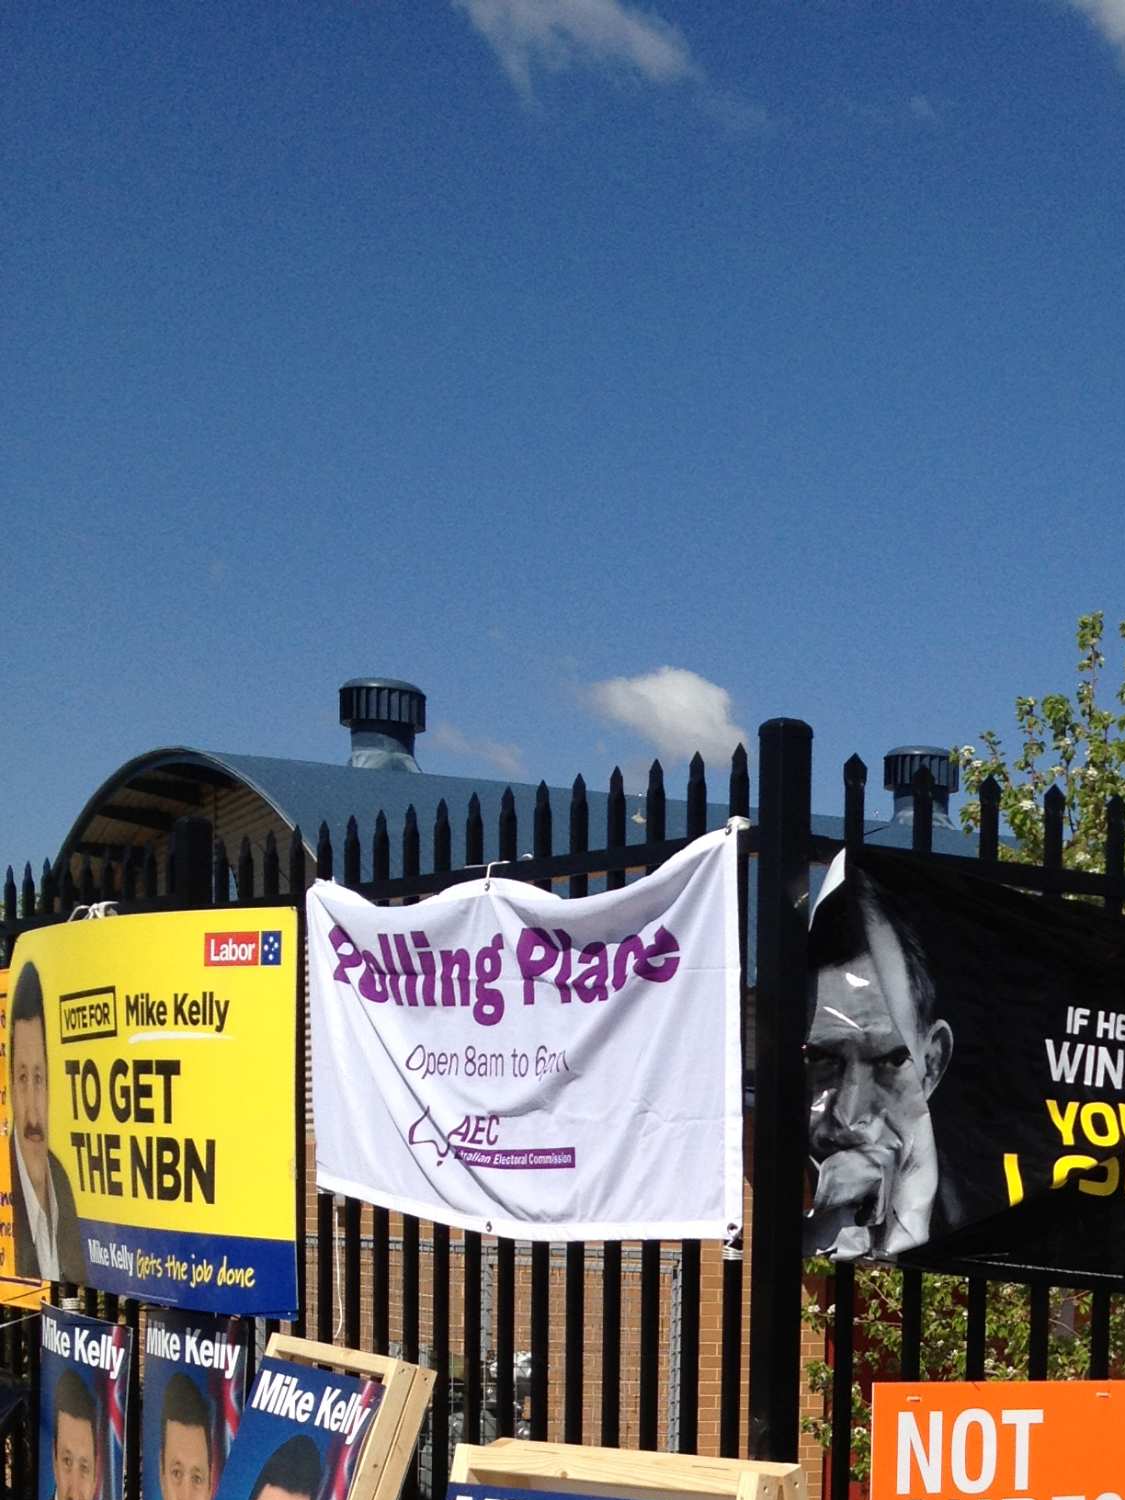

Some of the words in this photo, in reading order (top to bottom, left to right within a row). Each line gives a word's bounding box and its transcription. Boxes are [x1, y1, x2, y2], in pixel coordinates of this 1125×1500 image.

[209, 938, 256, 963] Labor
[328, 925, 505, 1027] Polling
[516, 925, 680, 1006] Place
[64, 1005, 88, 1032] VOTE
[88, 1002, 111, 1029] FOR
[125, 994, 167, 1028] Mike
[173, 991, 230, 1034] Kelly
[1067, 1005, 1089, 1036] IF
[405, 1044, 459, 1080] Open
[464, 1045, 504, 1078] 8am
[511, 1048, 529, 1078] to
[65, 1059, 101, 1122] TO
[110, 1059, 181, 1124] GET
[452, 1114, 500, 1146] AEC
[70, 1132, 123, 1197] THE
[131, 1137, 216, 1204] NBN
[493, 1154, 527, 1165] Electoral
[529, 1153, 572, 1165] Commission
[88, 1238, 109, 1266] Mike
[109, 1242, 134, 1276] Kelly
[136, 1248, 163, 1280] Gets
[165, 1254, 188, 1280] the
[190, 1253, 213, 1288] job
[216, 1256, 256, 1288] done
[42, 1315, 71, 1357] Mike
[74, 1329, 125, 1380] Kelly
[147, 1320, 181, 1362] Mike
[185, 1327, 241, 1379] Kelly
[251, 1370, 314, 1421] Mike
[314, 1385, 371, 1444] Kelly
[896, 1408, 1044, 1495] NOT
